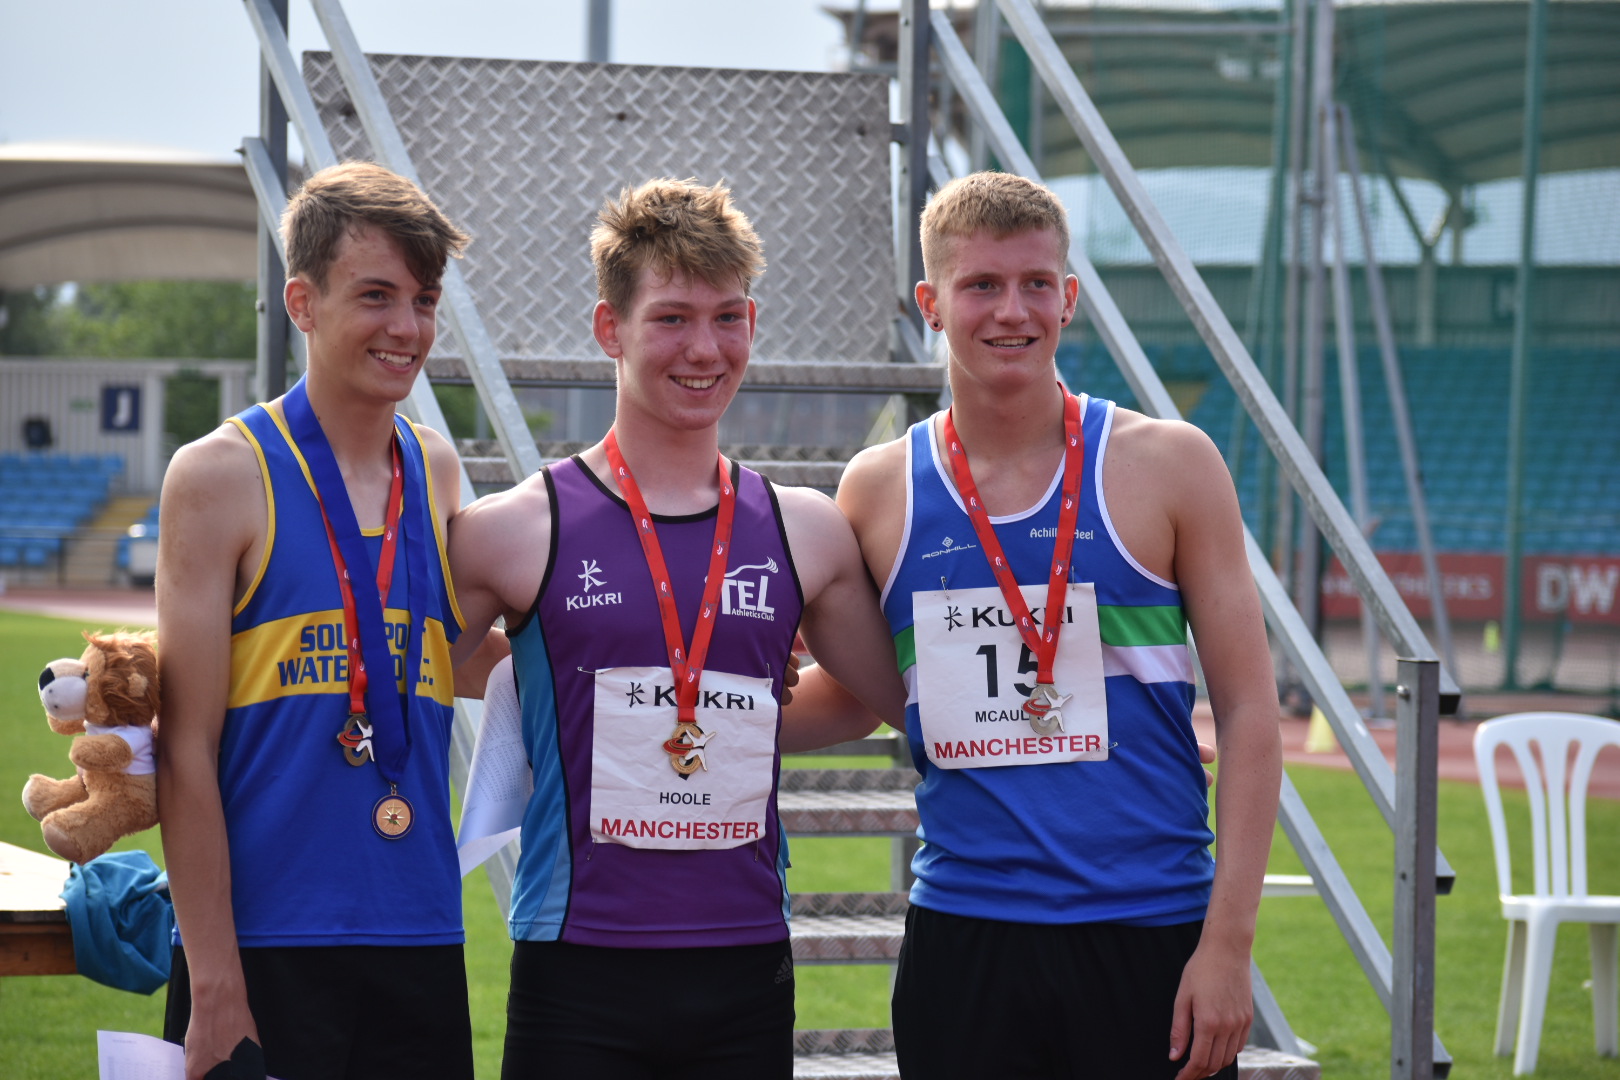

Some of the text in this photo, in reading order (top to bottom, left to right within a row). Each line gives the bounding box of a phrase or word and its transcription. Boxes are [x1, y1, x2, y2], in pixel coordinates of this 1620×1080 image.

[111, 390, 132, 428] J
[566, 592, 623, 611] KUKRI
[731, 608, 775, 622] Athletics Club
[934, 735, 1101, 759] MANCHESTER
[659, 792, 712, 806] HOOLE
[601, 817, 760, 840] MANCHESTER
